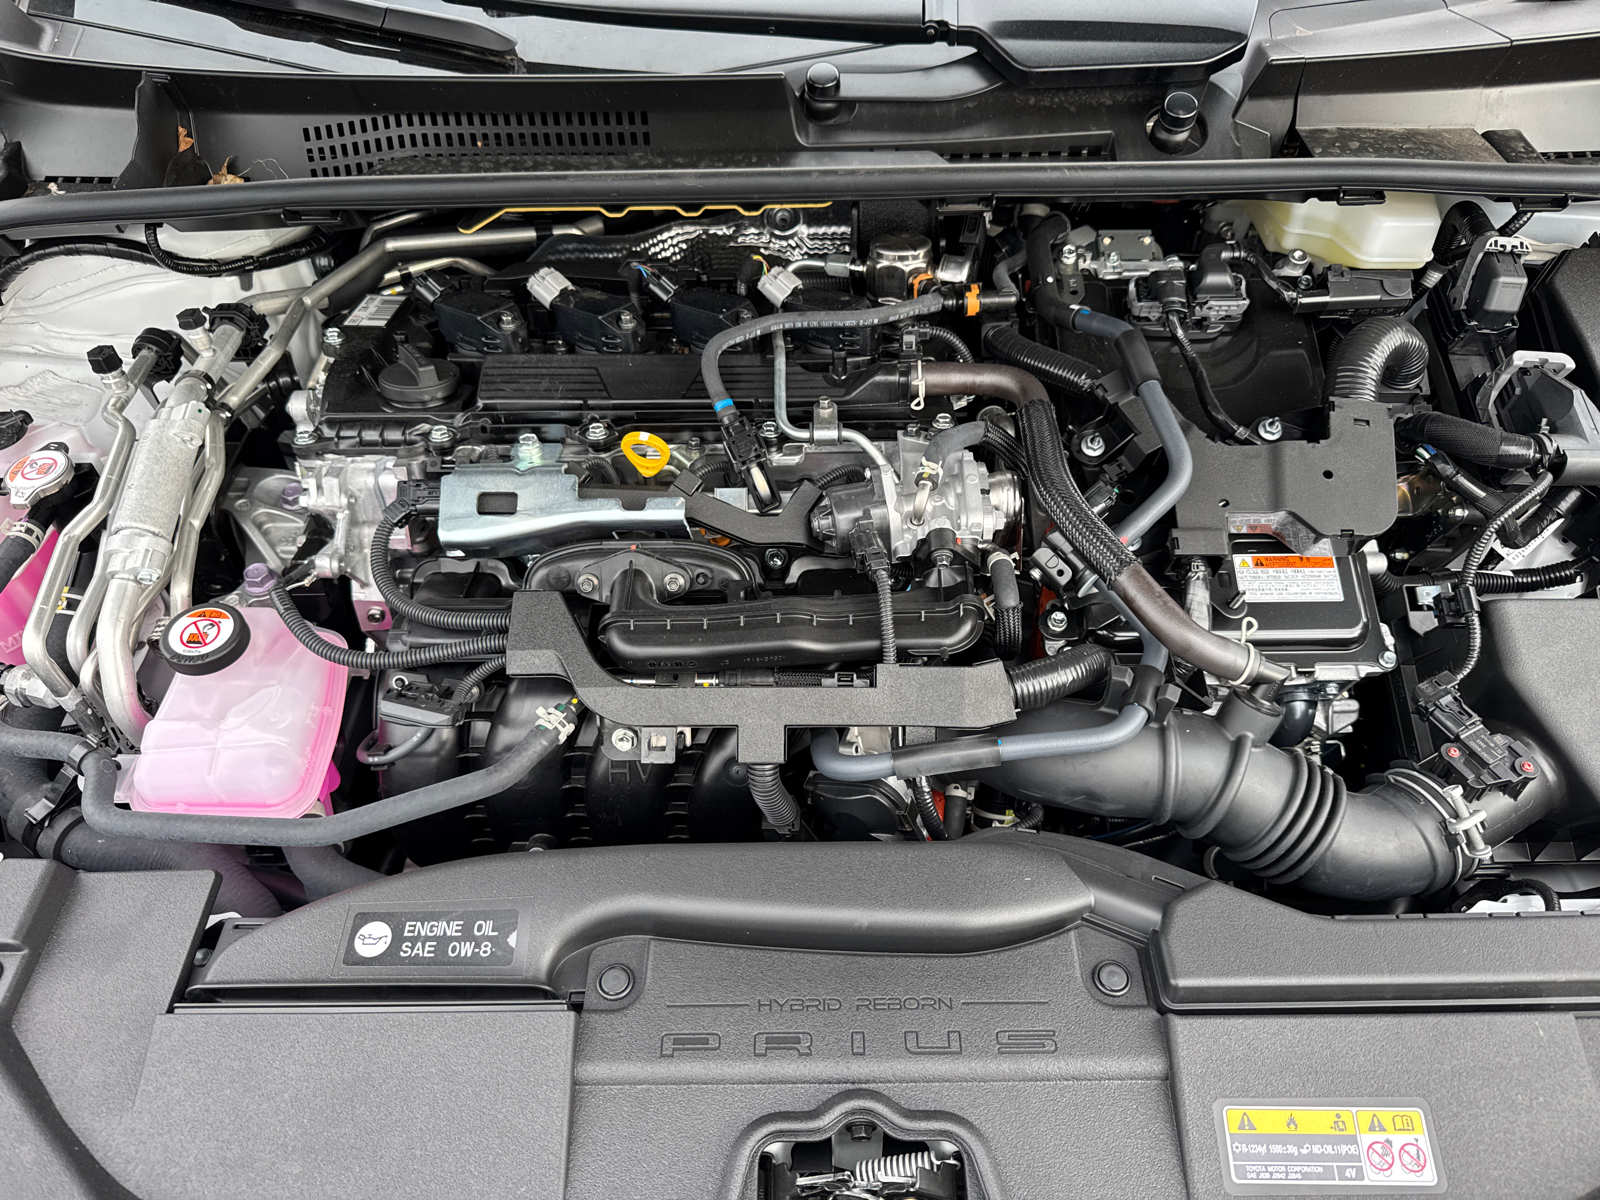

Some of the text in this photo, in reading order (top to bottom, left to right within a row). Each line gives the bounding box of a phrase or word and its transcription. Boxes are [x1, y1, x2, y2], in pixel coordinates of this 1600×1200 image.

[170, 652, 209, 664] DENSO
[403, 920, 499, 936] ENGINE OIL
[400, 941, 492, 957] SAE 0W-8
[757, 997, 953, 1012] HYBRID REBORN
[660, 1029, 1058, 1058] PRIUS
[1287, 1165, 1323, 1173] CORPORATION
